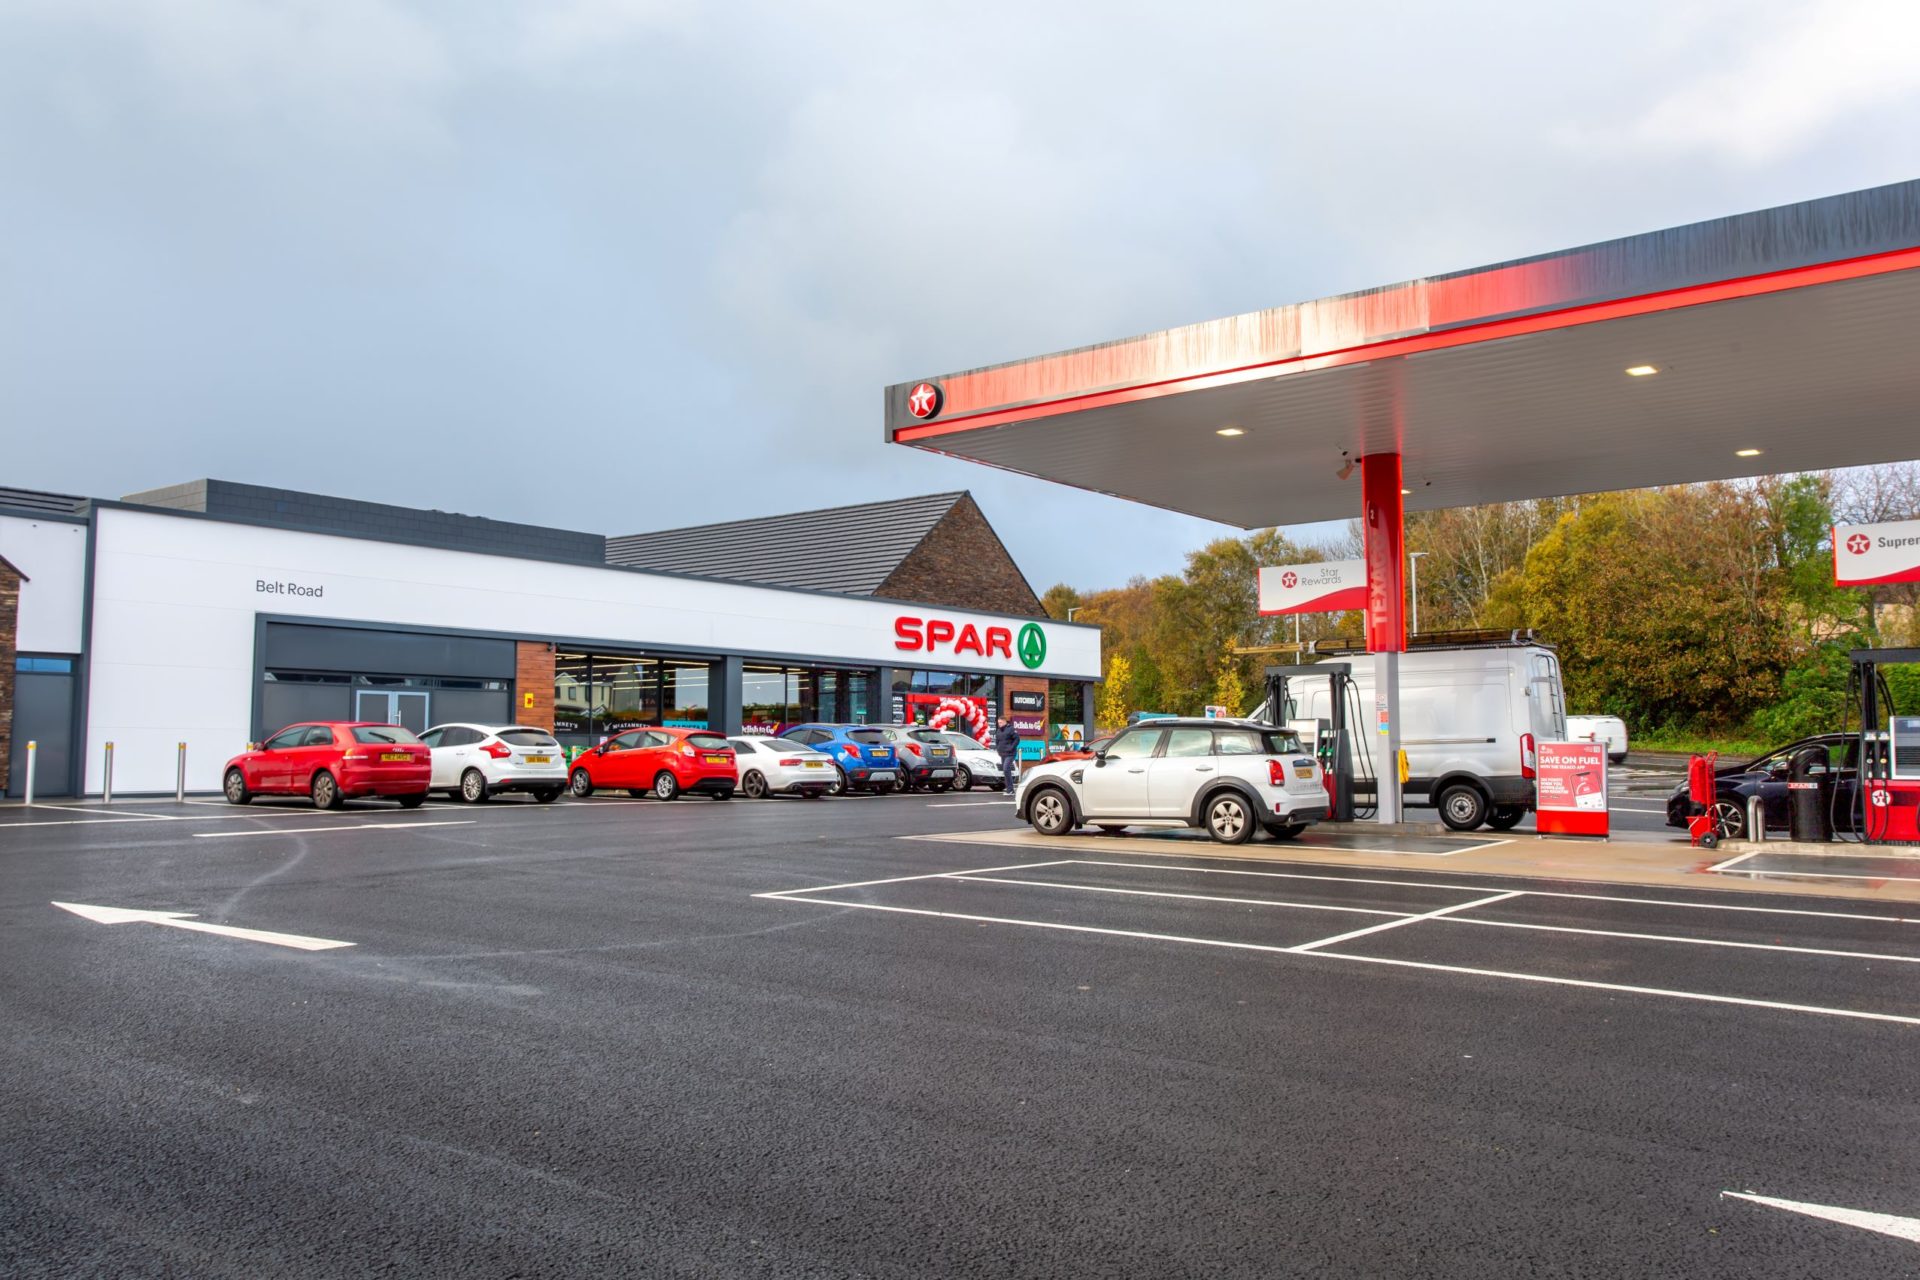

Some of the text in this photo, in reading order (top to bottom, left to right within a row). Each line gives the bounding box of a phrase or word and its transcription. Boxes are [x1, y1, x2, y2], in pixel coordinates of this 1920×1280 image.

[1320, 568, 1339, 578] Star
[1301, 576, 1342, 586] Rewards
[1371, 534, 1388, 628] TEXACO
[256, 580, 323, 597] Belt Road
[895, 616, 1012, 659] SPAR
[1014, 696, 1036, 705] BUTCHERS
[1013, 721, 1029, 730] Delish
[1540, 756, 1601, 765] SAVE ON FUEL
